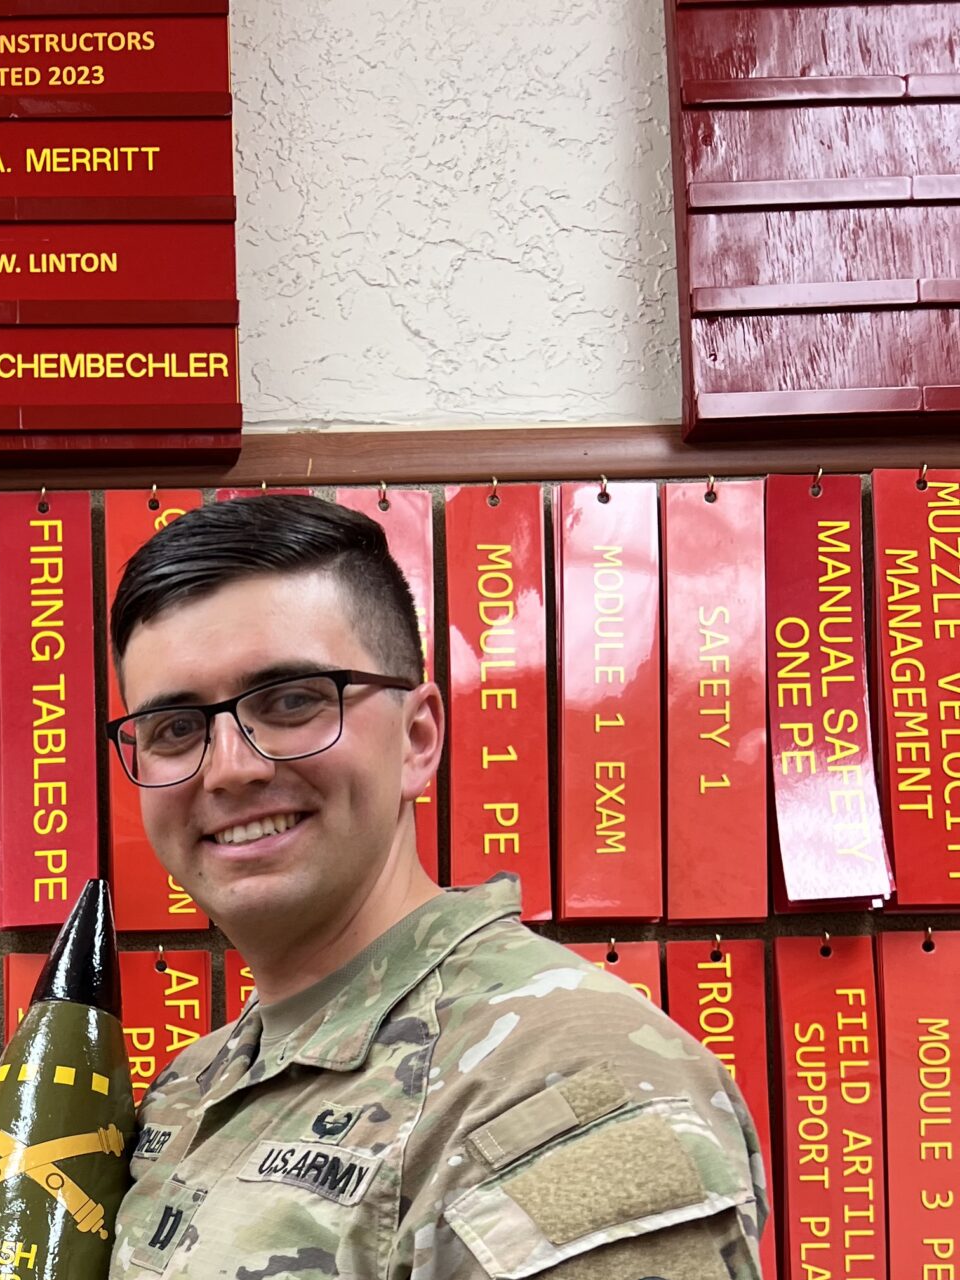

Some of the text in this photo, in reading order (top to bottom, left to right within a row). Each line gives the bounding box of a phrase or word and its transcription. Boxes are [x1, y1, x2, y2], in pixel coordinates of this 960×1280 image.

[48, 65, 105, 86] 2023
[26, 146, 161, 173] MERRITT
[29, 252, 118, 273] LINTON
[926, 481, 960, 640] MUZZLE
[29, 519, 68, 903] FIRING TABLES PE
[476, 543, 520, 855] MODULE 1 PE
[592, 544, 627, 854] MODULE 1 EXAM
[698, 605, 732, 794] SAFETY 1
[775, 616, 817, 773] ONE PE
[817, 520, 874, 864] MANUAL SAFETY
[884, 548, 934, 819] MANAGEMENT
[794, 1022, 830, 1189] SUPPORT
[835, 988, 871, 1105] FIELD
[917, 1017, 953, 1161] MODULE
[921, 1189, 955, 1210] 3
